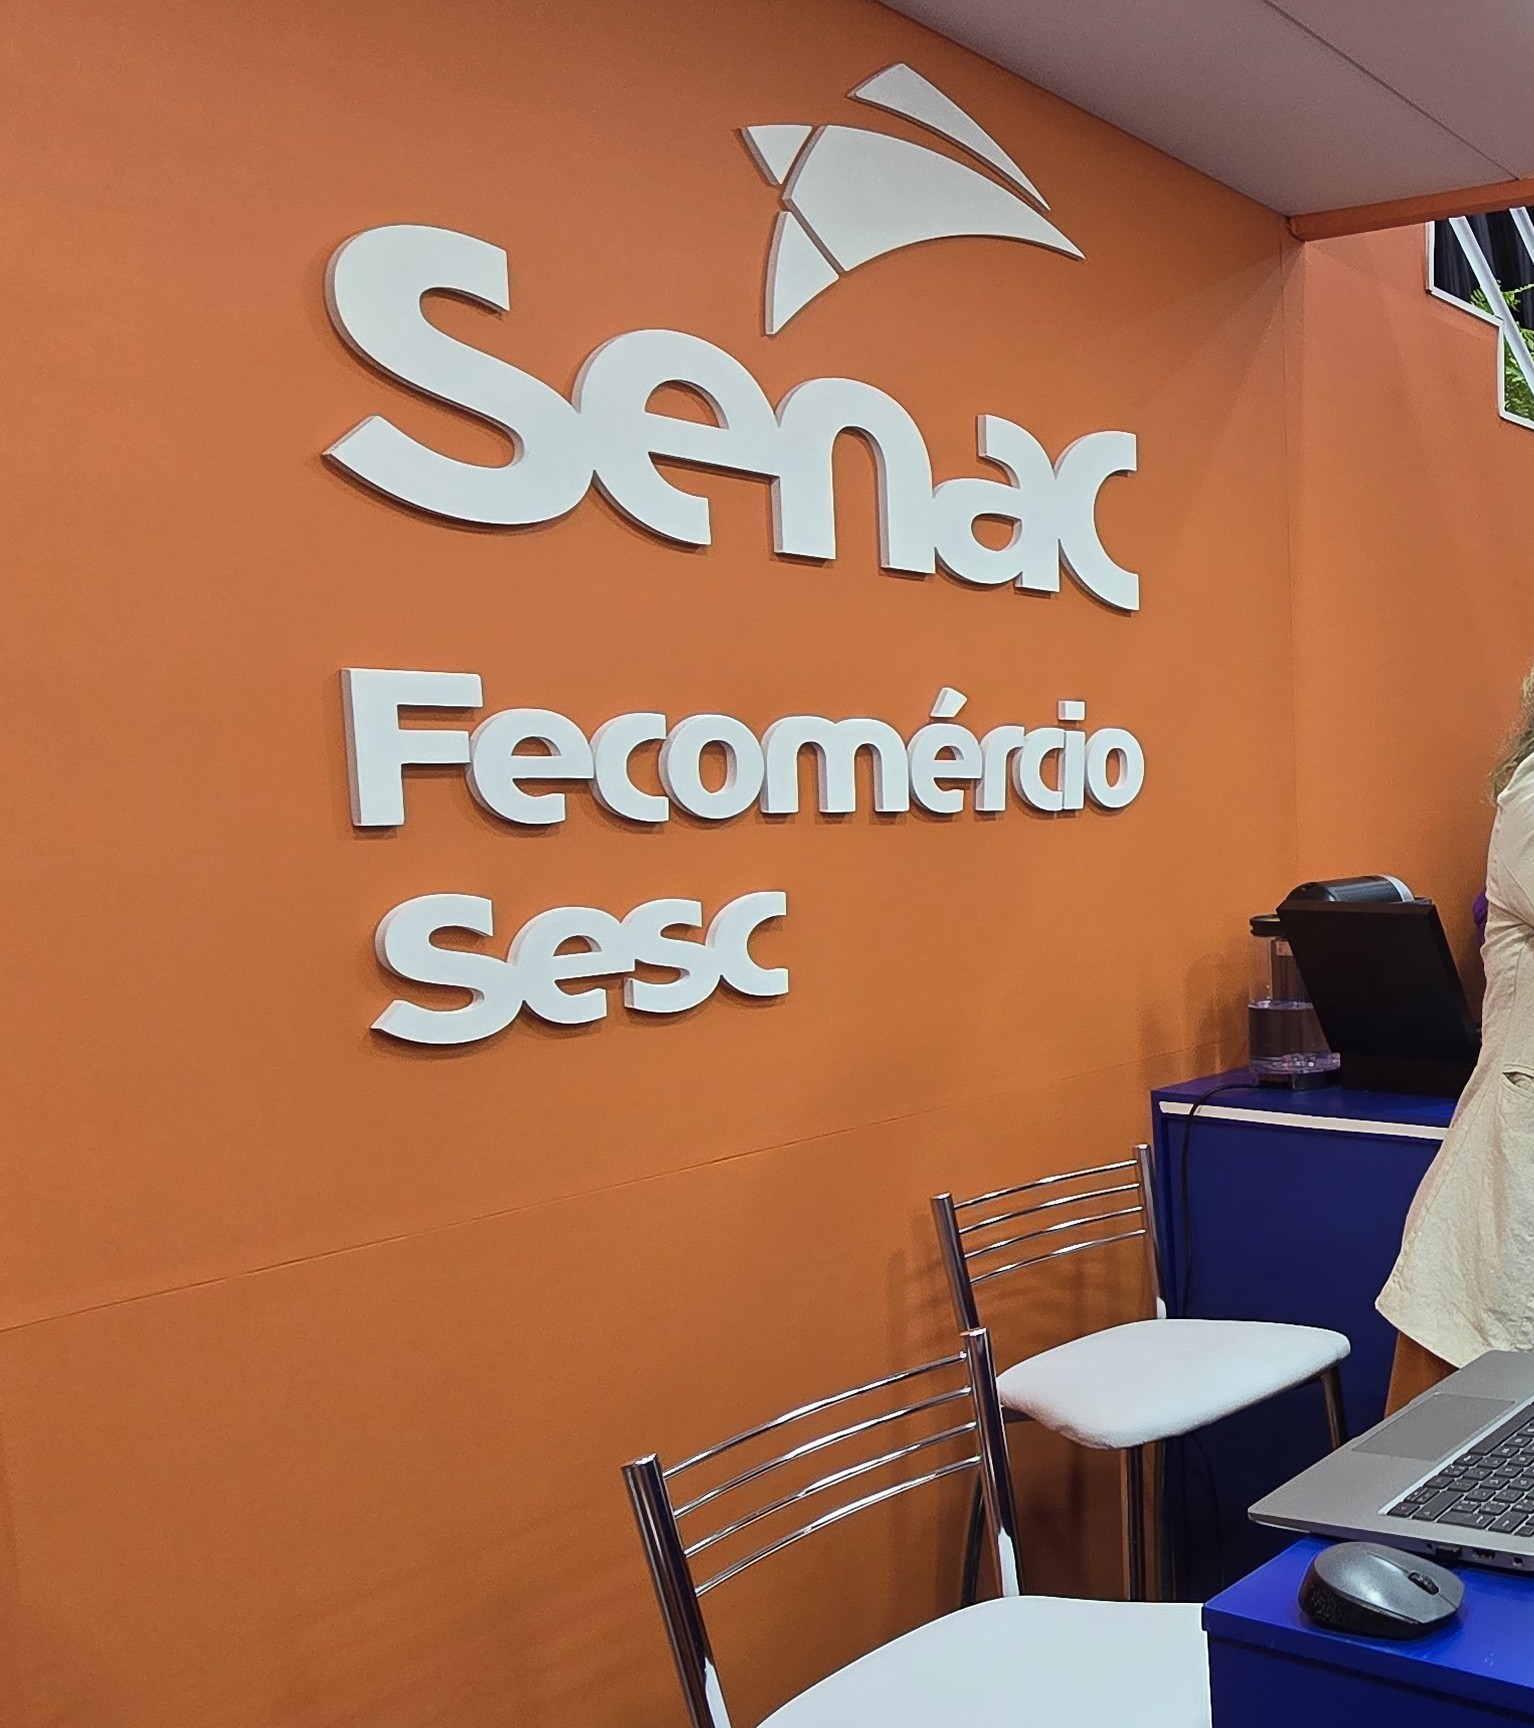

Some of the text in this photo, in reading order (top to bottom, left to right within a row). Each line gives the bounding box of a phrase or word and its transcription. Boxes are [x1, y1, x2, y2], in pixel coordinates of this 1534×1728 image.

[322, 224, 1140, 611] Senac
[342, 667, 1145, 827] Fecomércio
[370, 891, 789, 1044] Sesc
